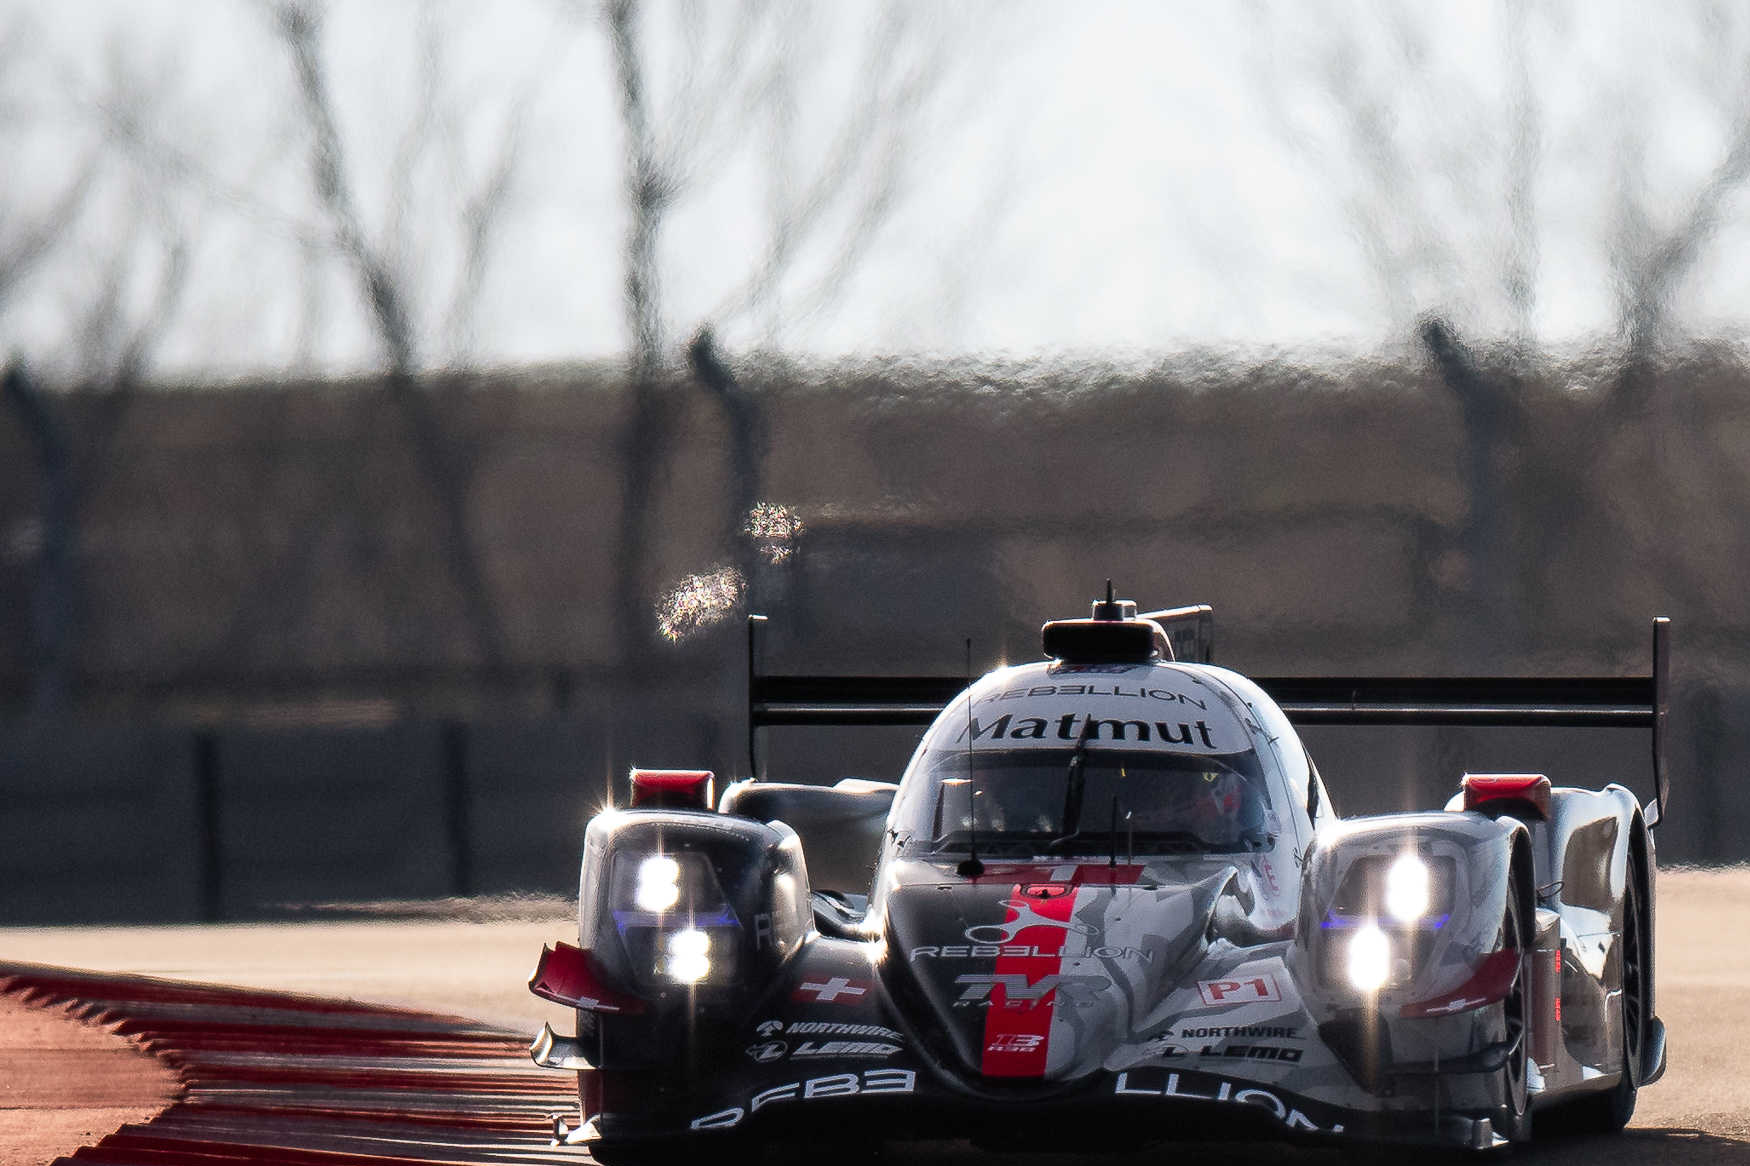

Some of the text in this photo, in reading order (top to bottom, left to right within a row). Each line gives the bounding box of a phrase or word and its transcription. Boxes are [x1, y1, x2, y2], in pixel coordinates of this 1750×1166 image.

[956, 712, 1218, 749] Matmut
[1206, 978, 1270, 1000] P1
[1182, 1025, 1303, 1040] NORTHWIRE
[1199, 1045, 1304, 1062] LEMO
